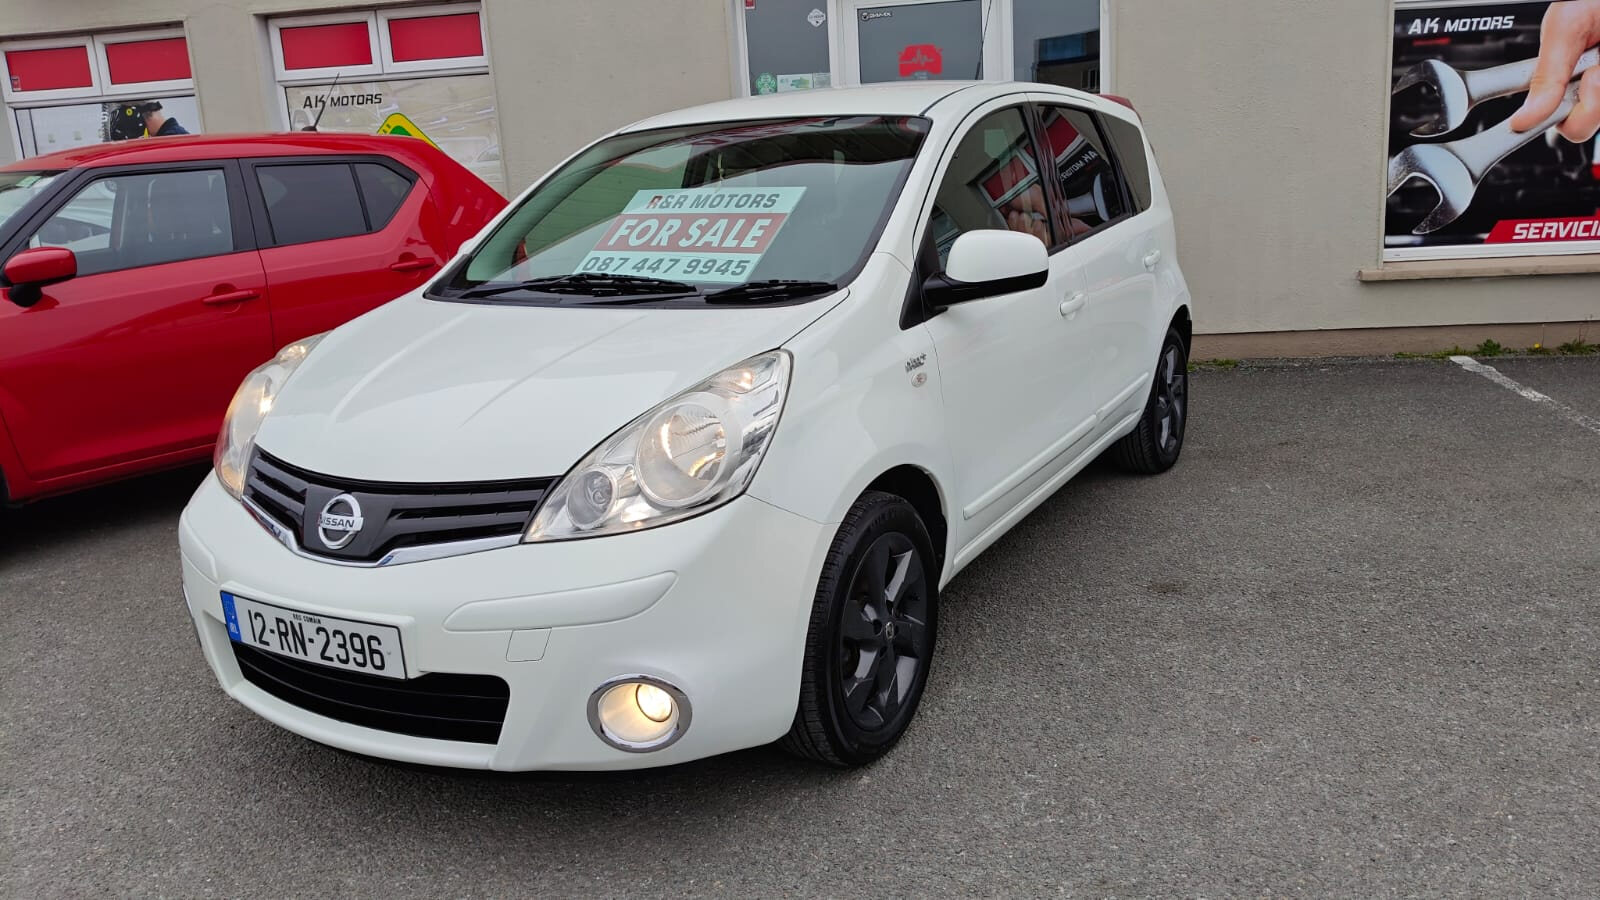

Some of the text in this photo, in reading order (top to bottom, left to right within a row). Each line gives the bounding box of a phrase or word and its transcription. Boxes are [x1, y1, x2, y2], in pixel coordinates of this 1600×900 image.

[1407, 15, 1515, 35] AK MOTORS
[303, 93, 383, 109] AK MOTORS
[646, 193, 780, 209] R&R MOTORS
[607, 218, 772, 248] FOR SALE
[1512, 220, 1600, 240] SERVICI
[582, 256, 751, 276] 087 447 9945
[320, 517, 355, 528] ISSAN
[248, 609, 386, 671] 12-RN-2396
